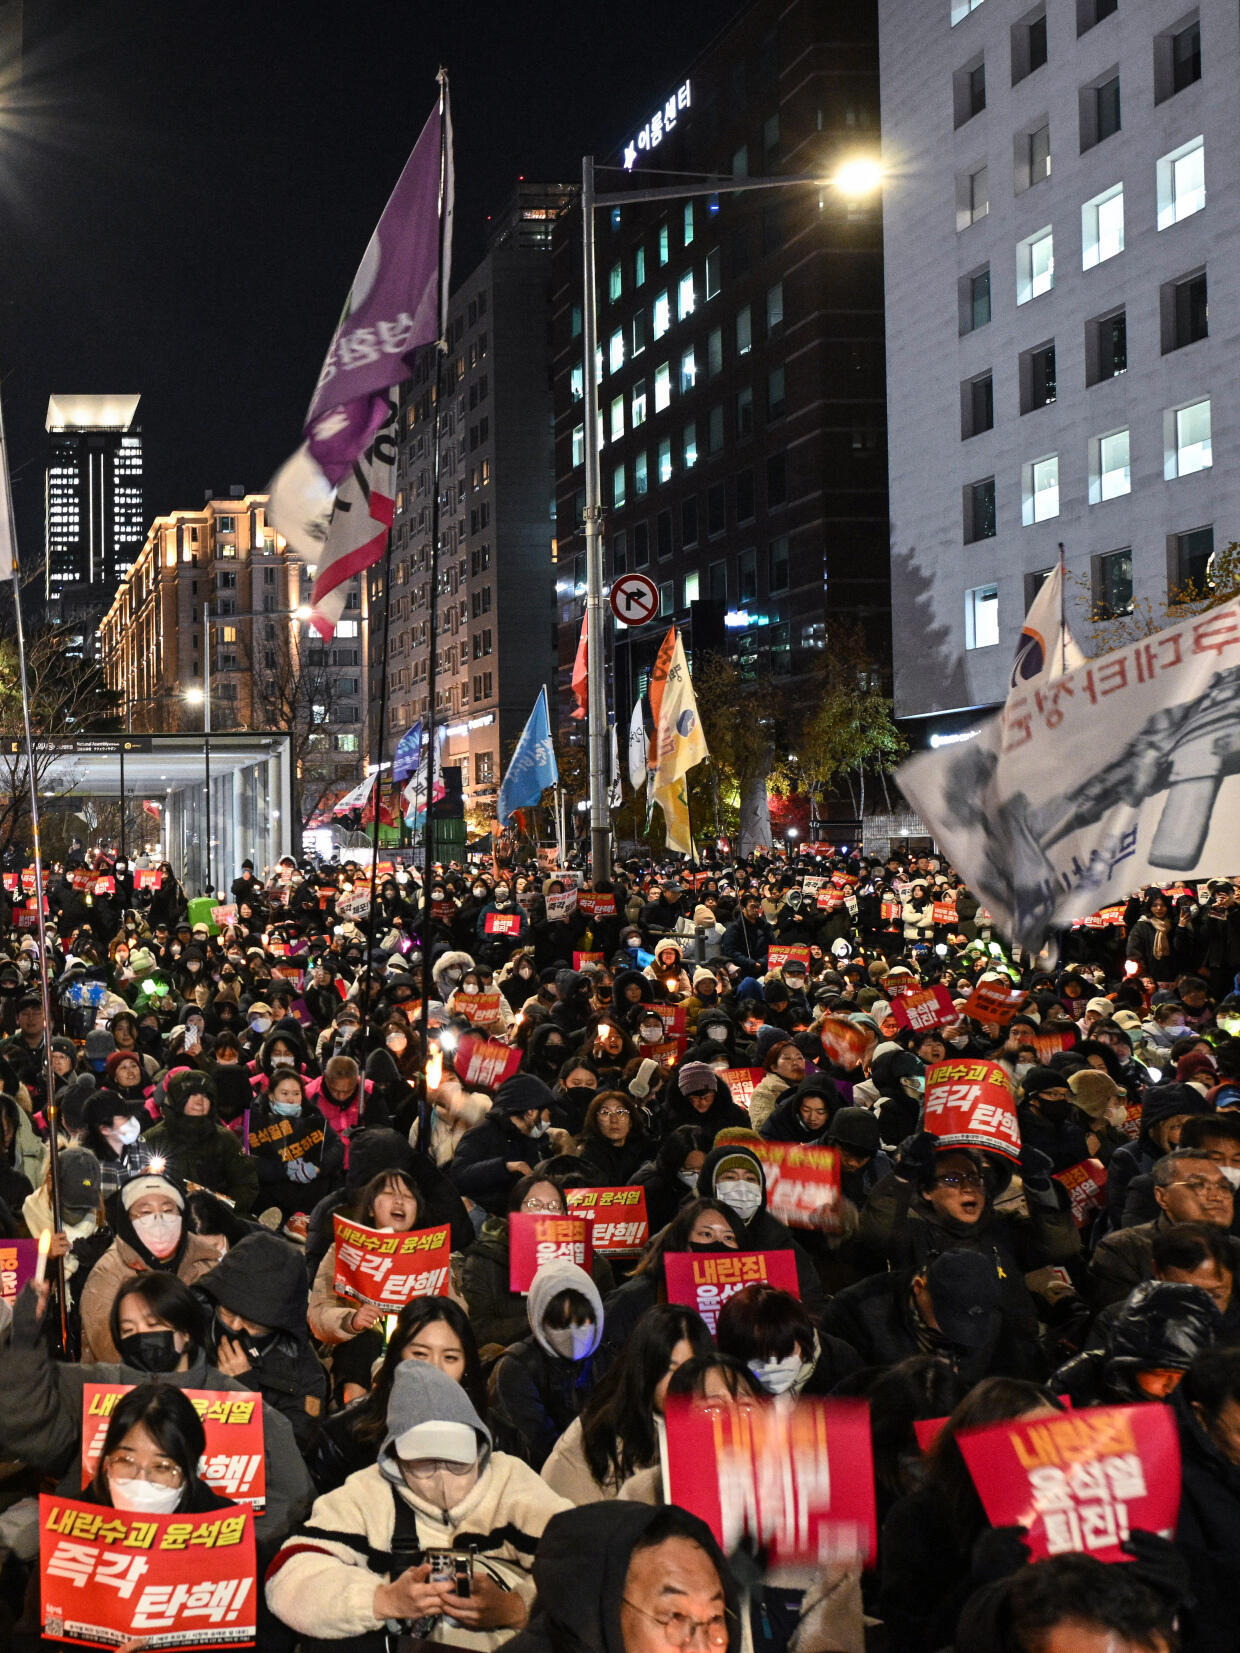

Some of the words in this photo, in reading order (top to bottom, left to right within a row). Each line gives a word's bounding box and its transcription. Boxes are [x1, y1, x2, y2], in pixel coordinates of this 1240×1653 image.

[927, 1065, 989, 1086] 내란수괴
[926, 1085, 982, 1115] 즉각
[248, 1119, 294, 1149] 윤석열을
[566, 1193, 597, 1207] 수괴
[599, 1191, 641, 1206] 윤석열
[336, 1224, 400, 1255] 내란수괴
[400, 1230, 448, 1255] 윤석열
[592, 1221, 646, 1245] 탄핵!
[337, 1242, 393, 1282] 즉각
[693, 1254, 768, 1285] 내란죄
[379, 1267, 448, 1301] 탄핵!
[197, 1455, 263, 1494] 핵!
[45, 1507, 158, 1550] 내란수괴
[159, 1514, 247, 1550] 윤석열
[46, 1541, 150, 1599] 즉각
[130, 1577, 254, 1629] 탄핵!
